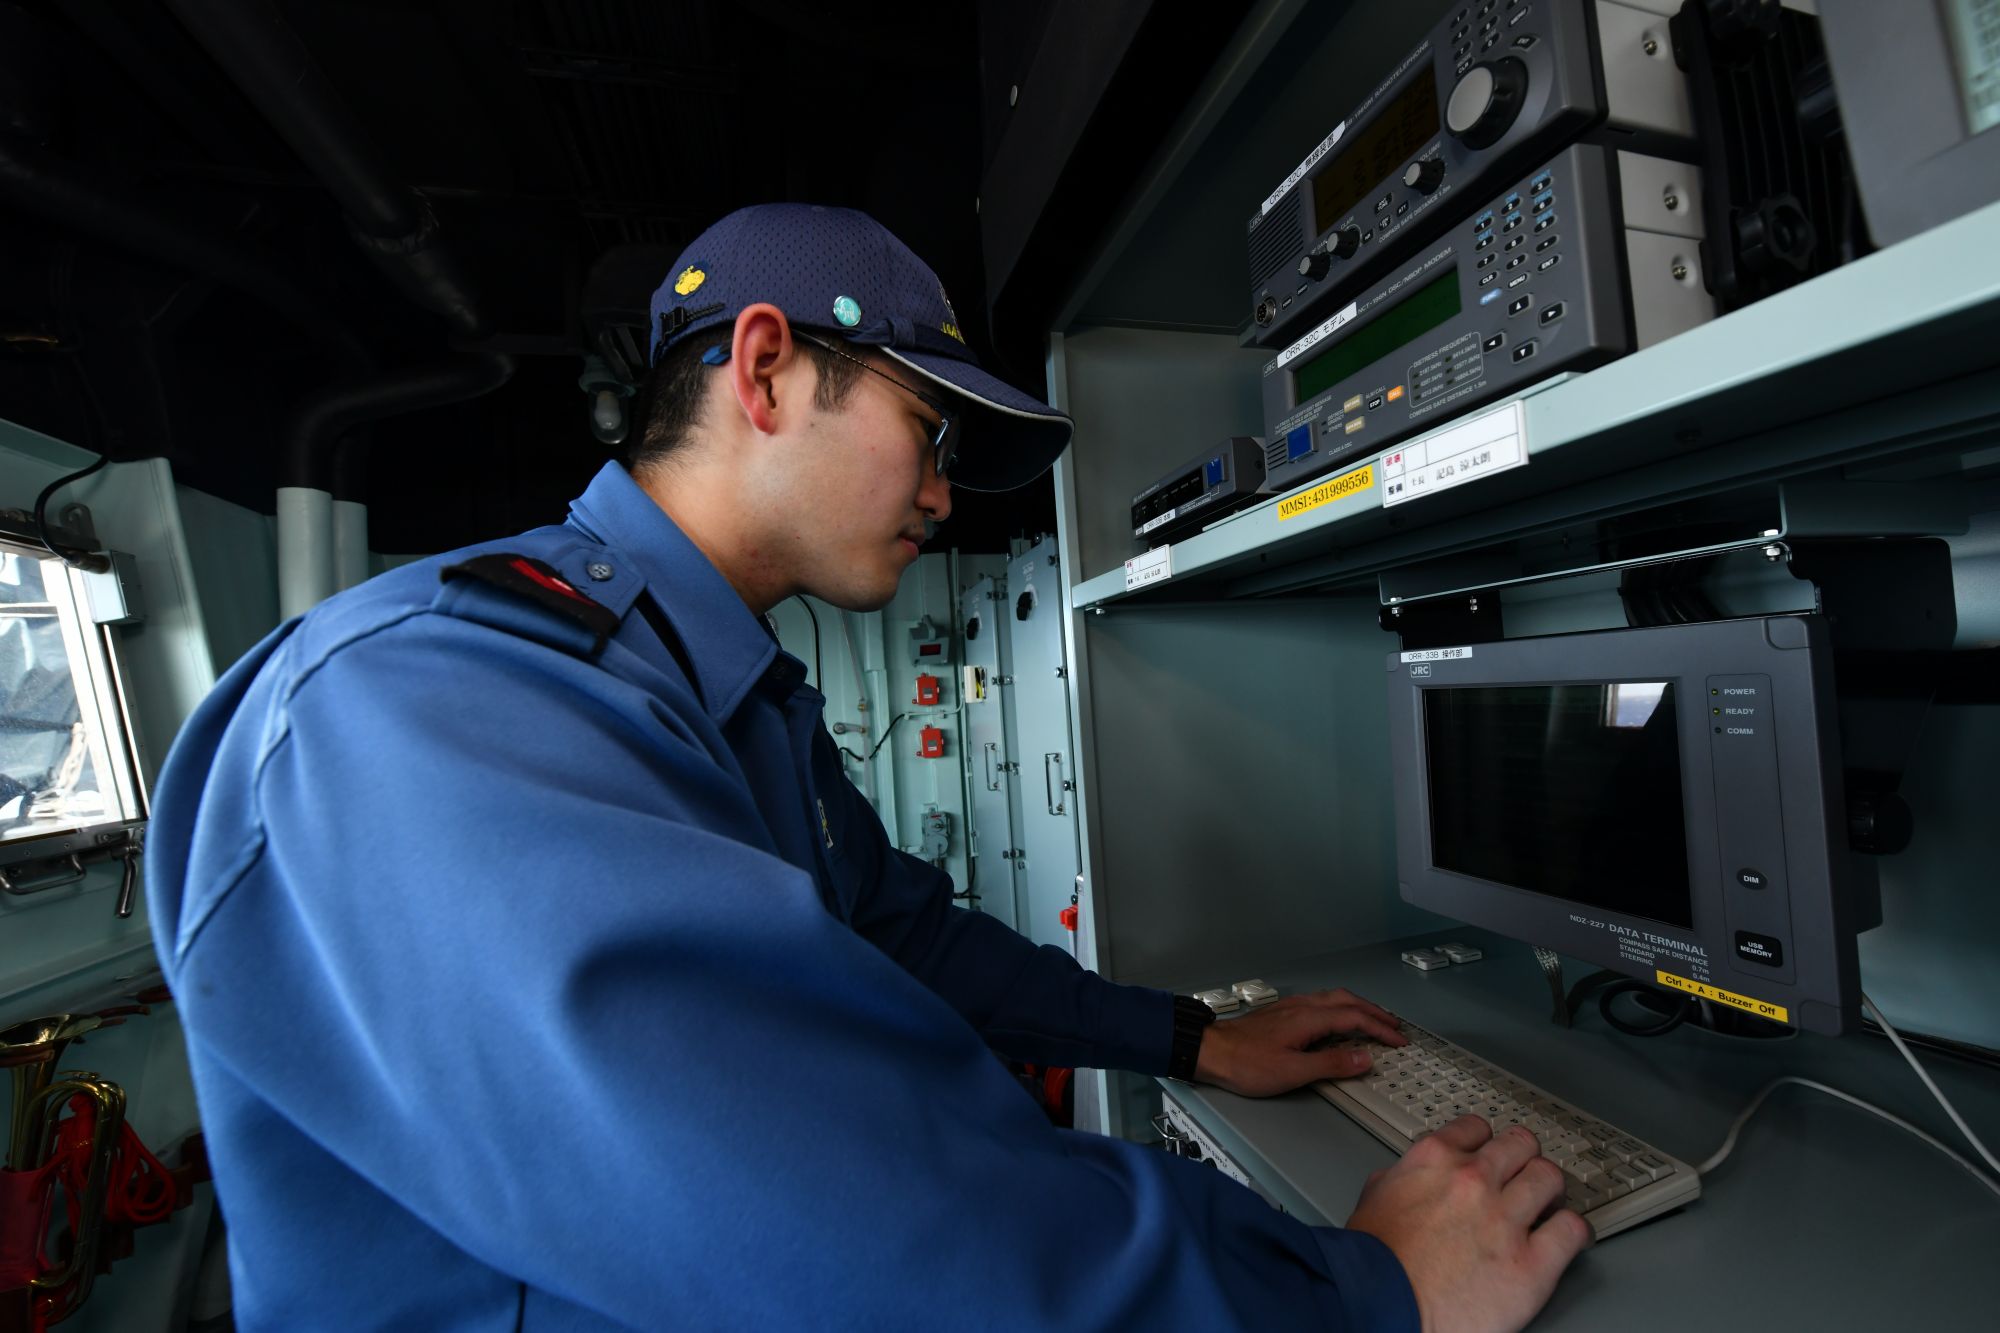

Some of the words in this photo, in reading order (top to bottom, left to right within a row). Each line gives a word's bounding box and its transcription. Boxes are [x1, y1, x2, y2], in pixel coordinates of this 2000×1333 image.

[1374, 39, 1429, 98] RADIOTELEPHONE
[1378, 223, 1401, 244] COMPASS
[1401, 213, 1414, 227] SAFE
[1413, 193, 1439, 217] DISTANCE
[1423, 246, 1452, 271] MODEM
[1541, 257, 1555, 269] ENT
[1482, 274, 1494, 284] CLR
[1509, 274, 1526, 288] MENU
[1322, 314, 1346, 335] モデム
[1413, 350, 1439, 368] DISTRESS
[1438, 333, 1472, 354] FREQUENCY
[1369, 399, 1381, 408] STOP
[1409, 404, 1433, 419] COMPASS
[1433, 399, 1447, 409] SAFE
[1447, 387, 1473, 402] DISTANCE
[1280, 470, 1369, 517] MMSI:431999556
[1442, 648, 1463, 659] 操作部
[1412, 666, 1429, 675] JRC
[1723, 688, 1756, 696] POWER
[1725, 707, 1755, 716] READY
[1727, 727, 1754, 735] COMM
[1743, 875, 1760, 884] DIM
[1569, 914, 1605, 930] NDZ-227
[1608, 923, 1640, 939] DATA
[1642, 932, 1708, 958] TERMINAL
[1618, 936, 1651, 950] COMPASS
[1652, 945, 1671, 956] SAFE
[1671, 951, 1709, 967] DISTANCE
[1740, 945, 1773, 959] MEMORY
[1747, 941, 1764, 950] USB
[1619, 944, 1655, 959] STANDARD
[1691, 965, 1710, 975] 0.7m
[1620, 951, 1654, 967] STEERING
[1665, 975, 1682, 987] Ctrl
[1697, 986, 1705, 994] A
[1718, 991, 1753, 1009] Buzzer
[1758, 1004, 1776, 1016] Off
